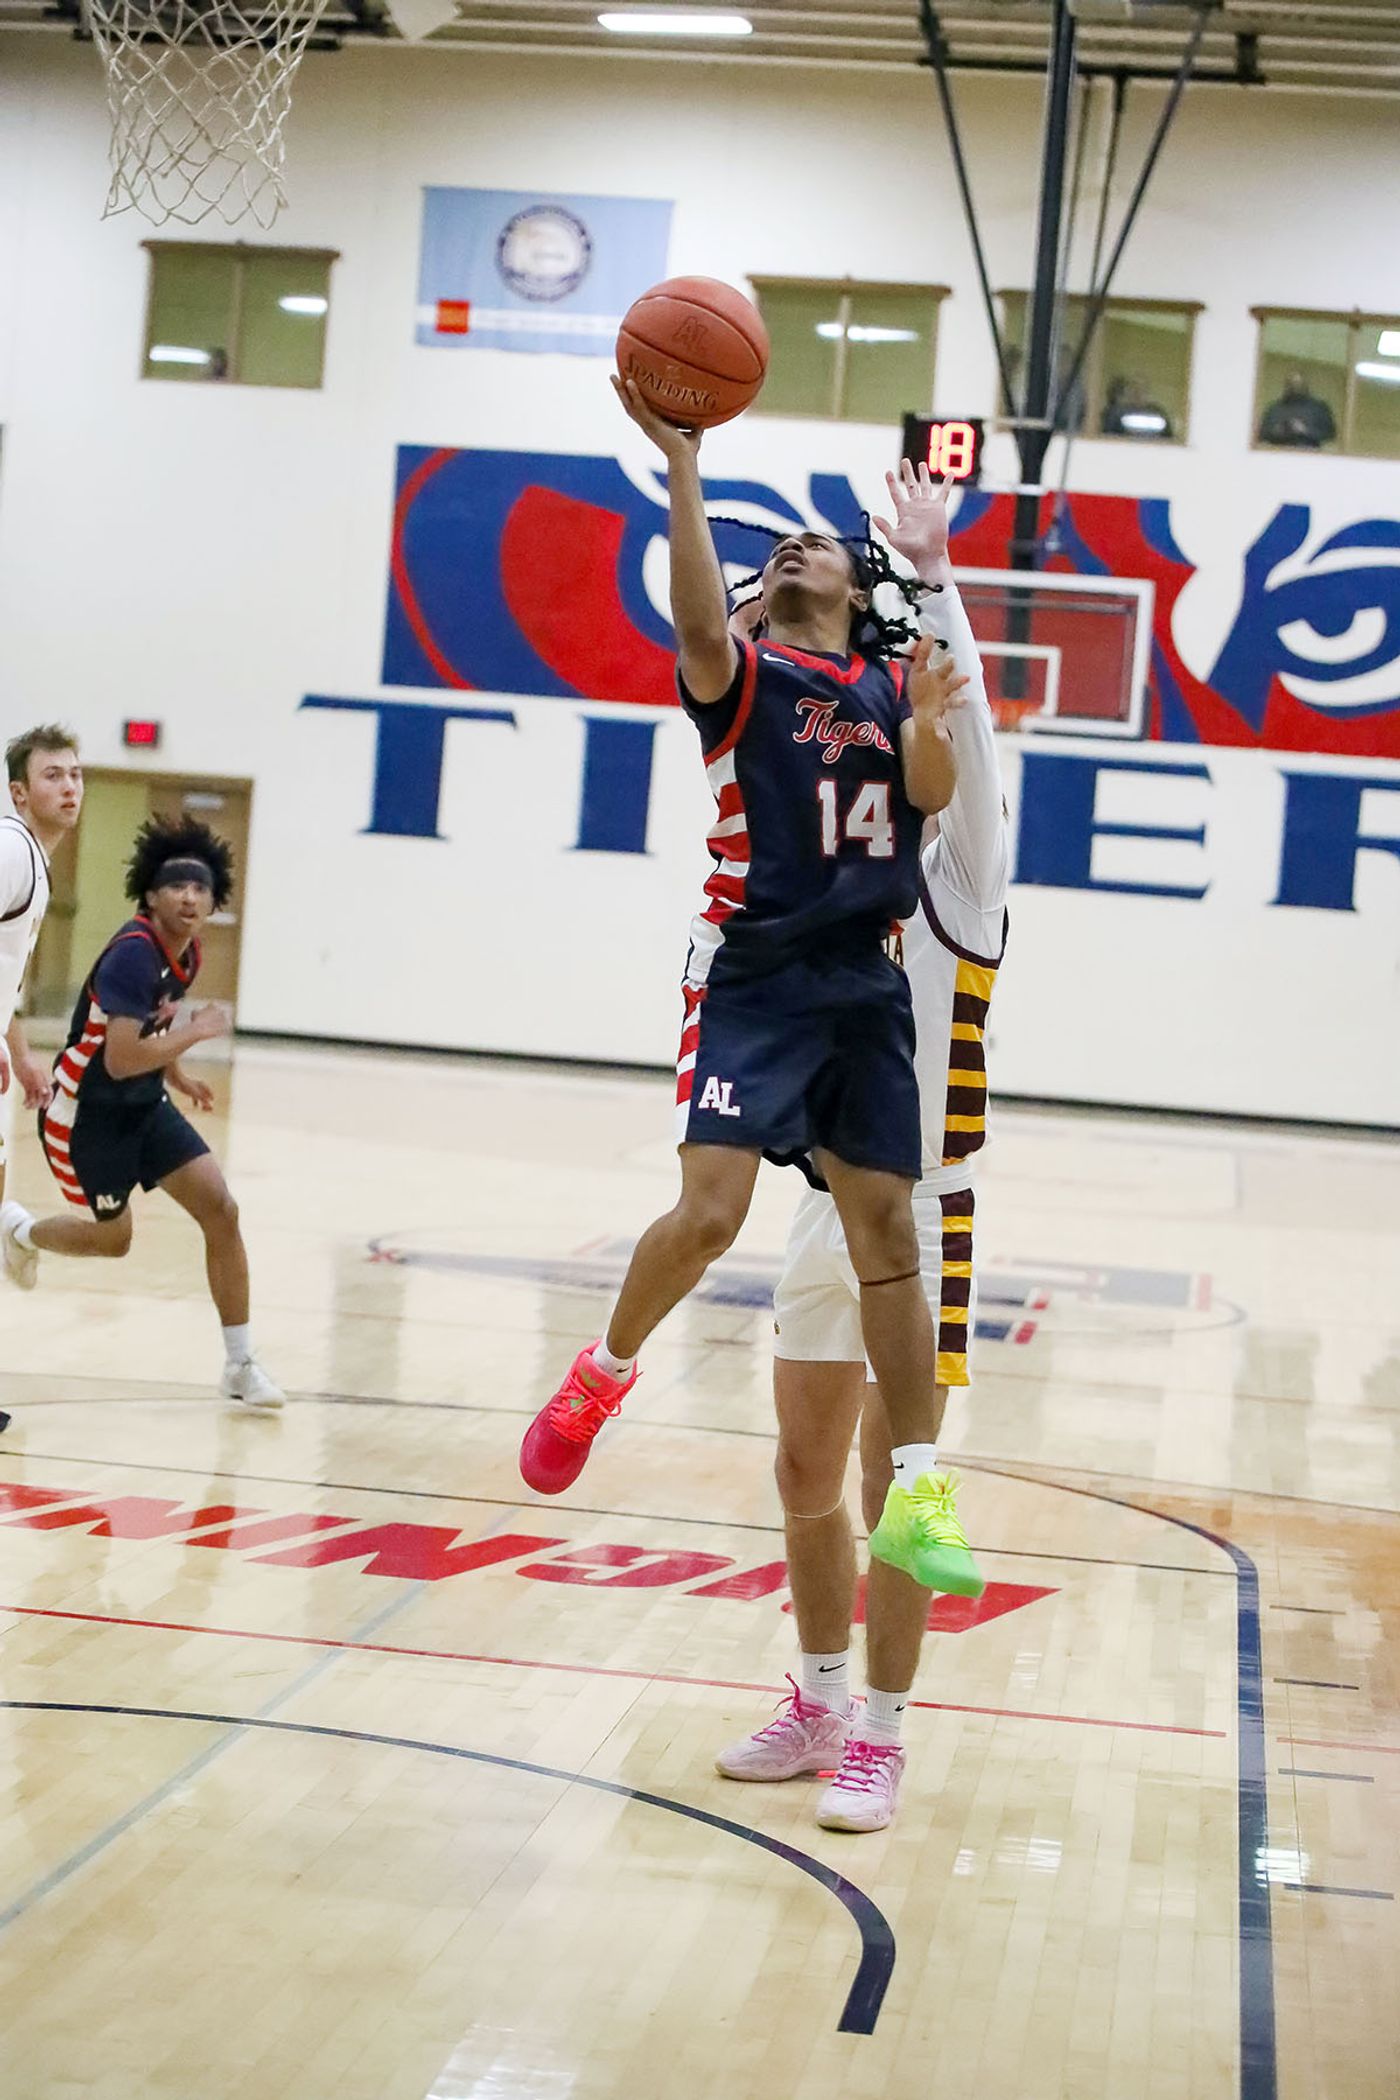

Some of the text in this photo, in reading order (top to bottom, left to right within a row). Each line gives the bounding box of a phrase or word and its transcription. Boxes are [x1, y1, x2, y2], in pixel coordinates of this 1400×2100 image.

[623, 352, 721, 411] SPALDING
[928, 421, 976, 479] 18
[793, 697, 896, 764] Tiger
[815, 778, 897, 860] 14
[697, 1076, 742, 1117] AL
